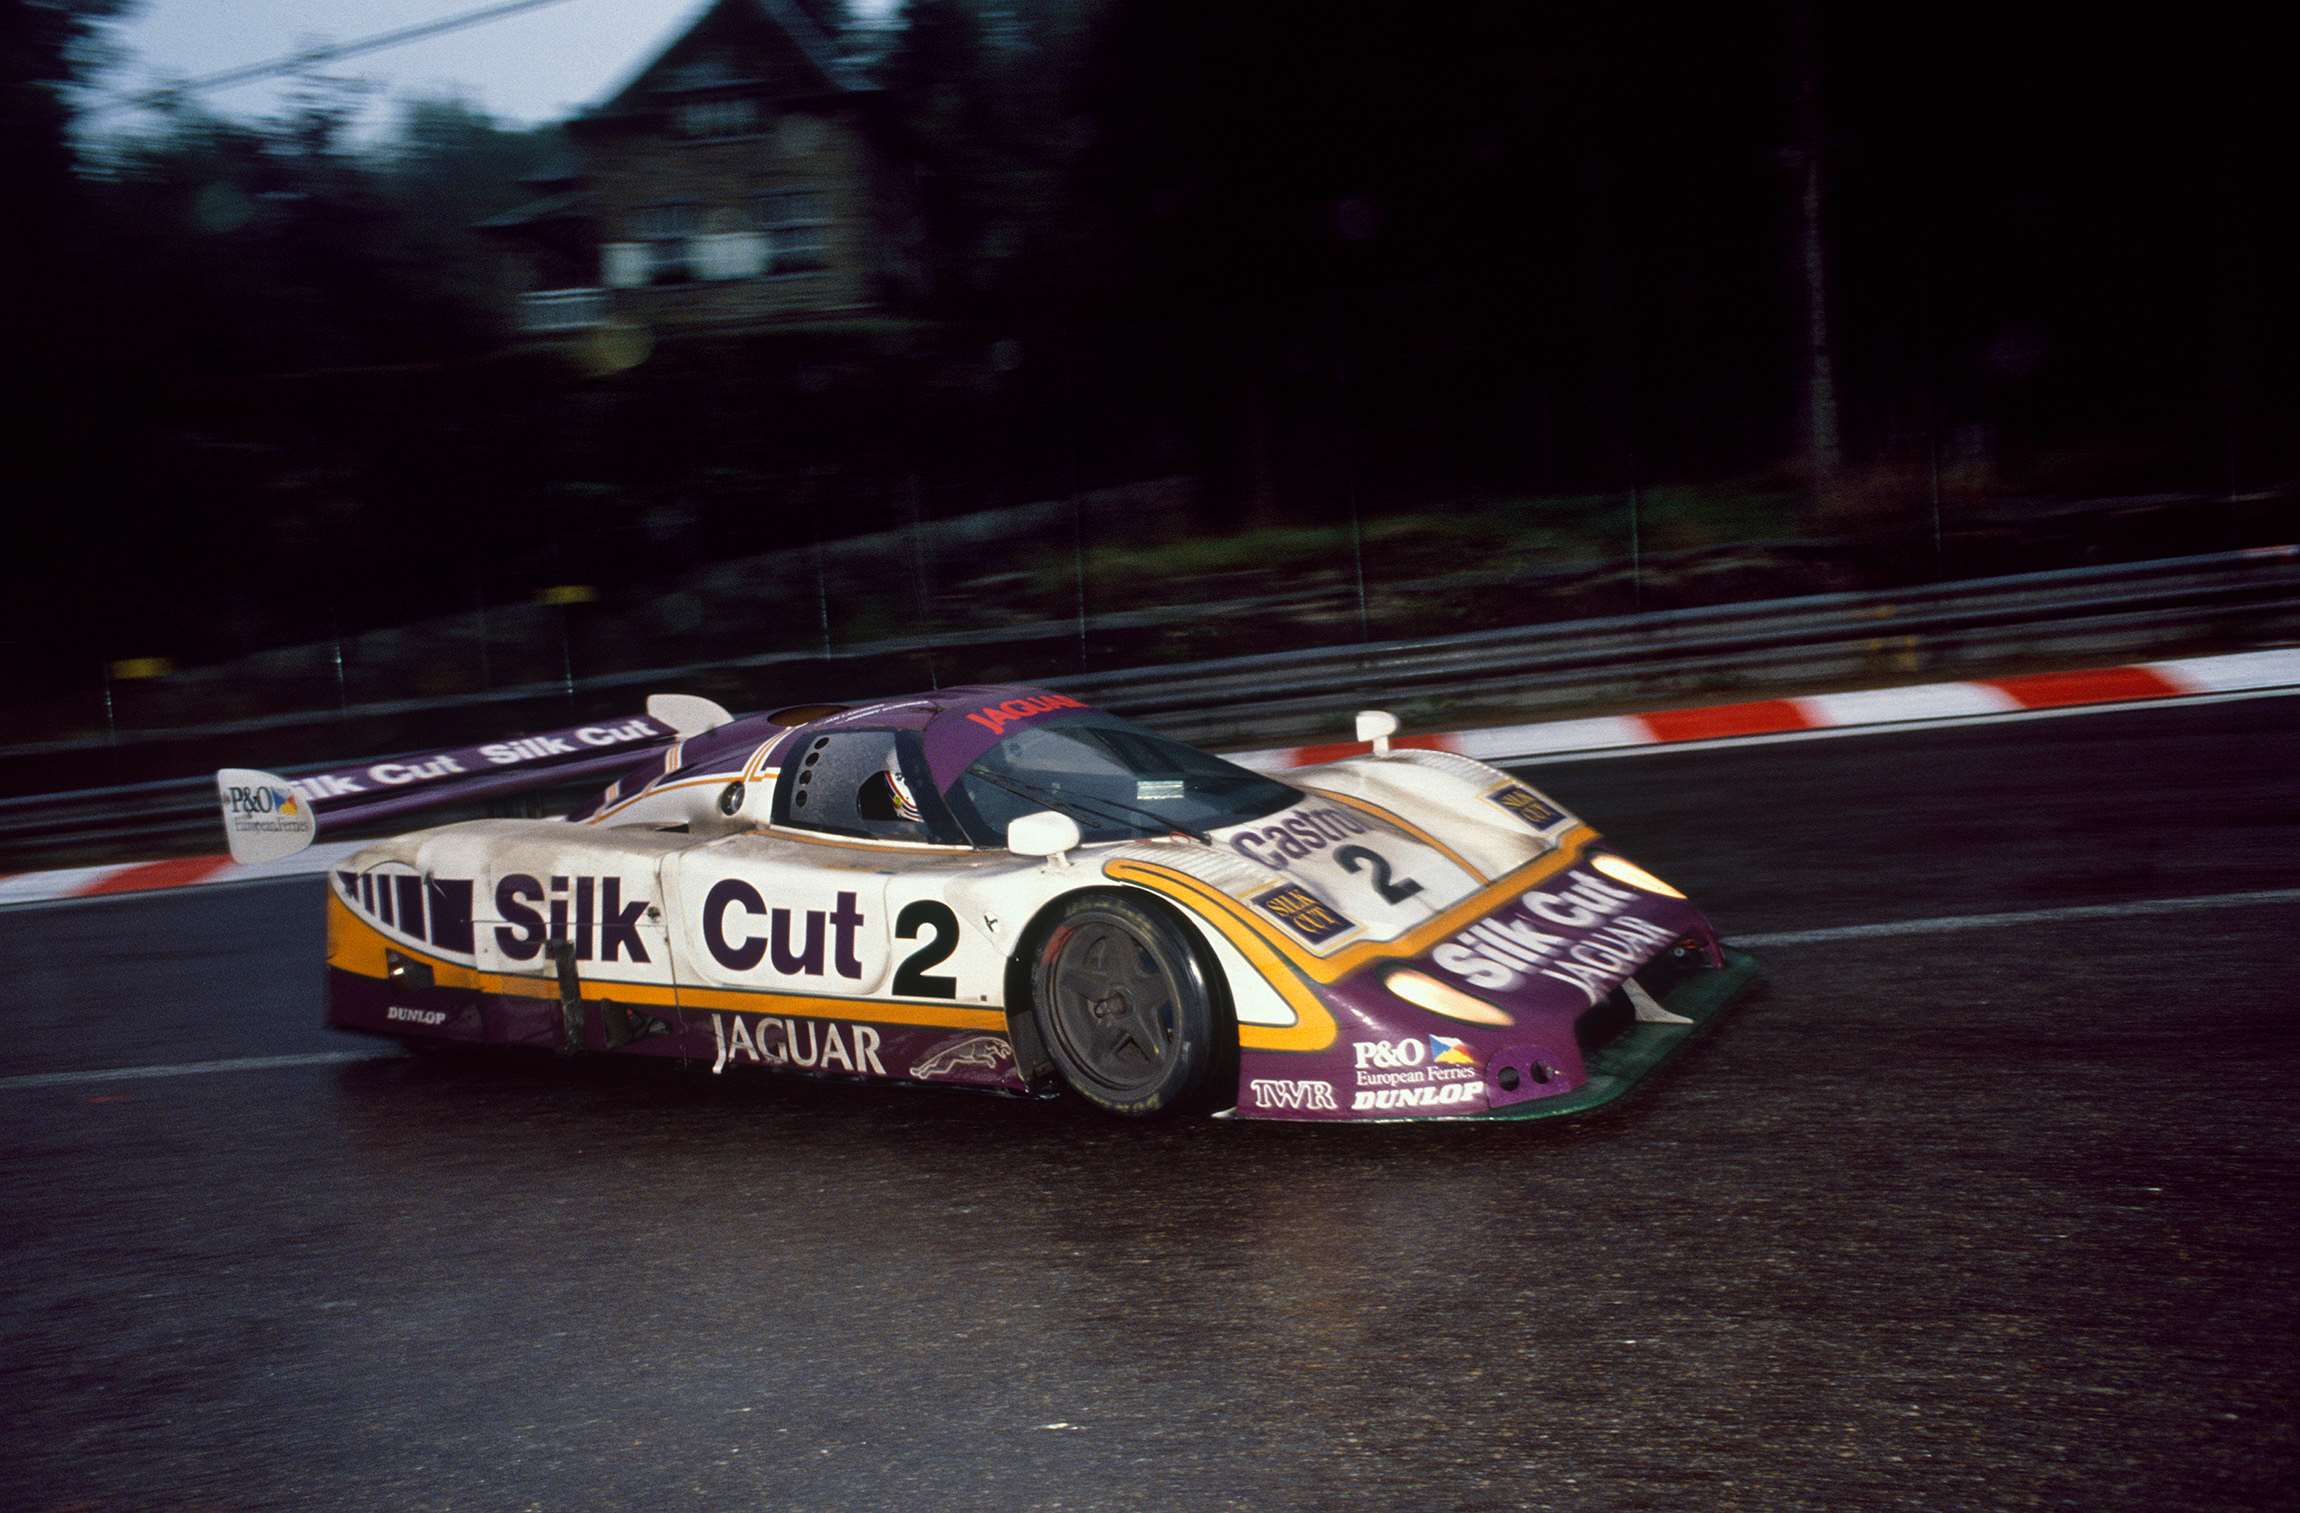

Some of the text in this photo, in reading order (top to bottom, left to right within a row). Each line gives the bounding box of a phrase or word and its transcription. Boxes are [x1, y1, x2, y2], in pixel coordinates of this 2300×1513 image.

[369, 755, 463, 786] Cut
[479, 734, 569, 766] Silk
[574, 719, 659, 747] Cut
[228, 786, 273, 815] P&O
[1333, 844, 1424, 906] 2
[494, 873, 652, 963] Silk
[703, 878, 865, 980] Cut
[892, 899, 960, 1000] 2
[1432, 869, 1640, 991] Silk Cut
[1539, 915, 1681, 1007] JAGUAR
[387, 1005, 446, 1025] DUNLOP
[711, 1013, 887, 1074] JAGUAR
[1352, 1038, 1424, 1069] P&O
[1250, 1079, 1337, 1109] TWR
[1351, 1081, 1484, 1110] DUNLOP
[1356, 1064, 1475, 1087] European Ferries
